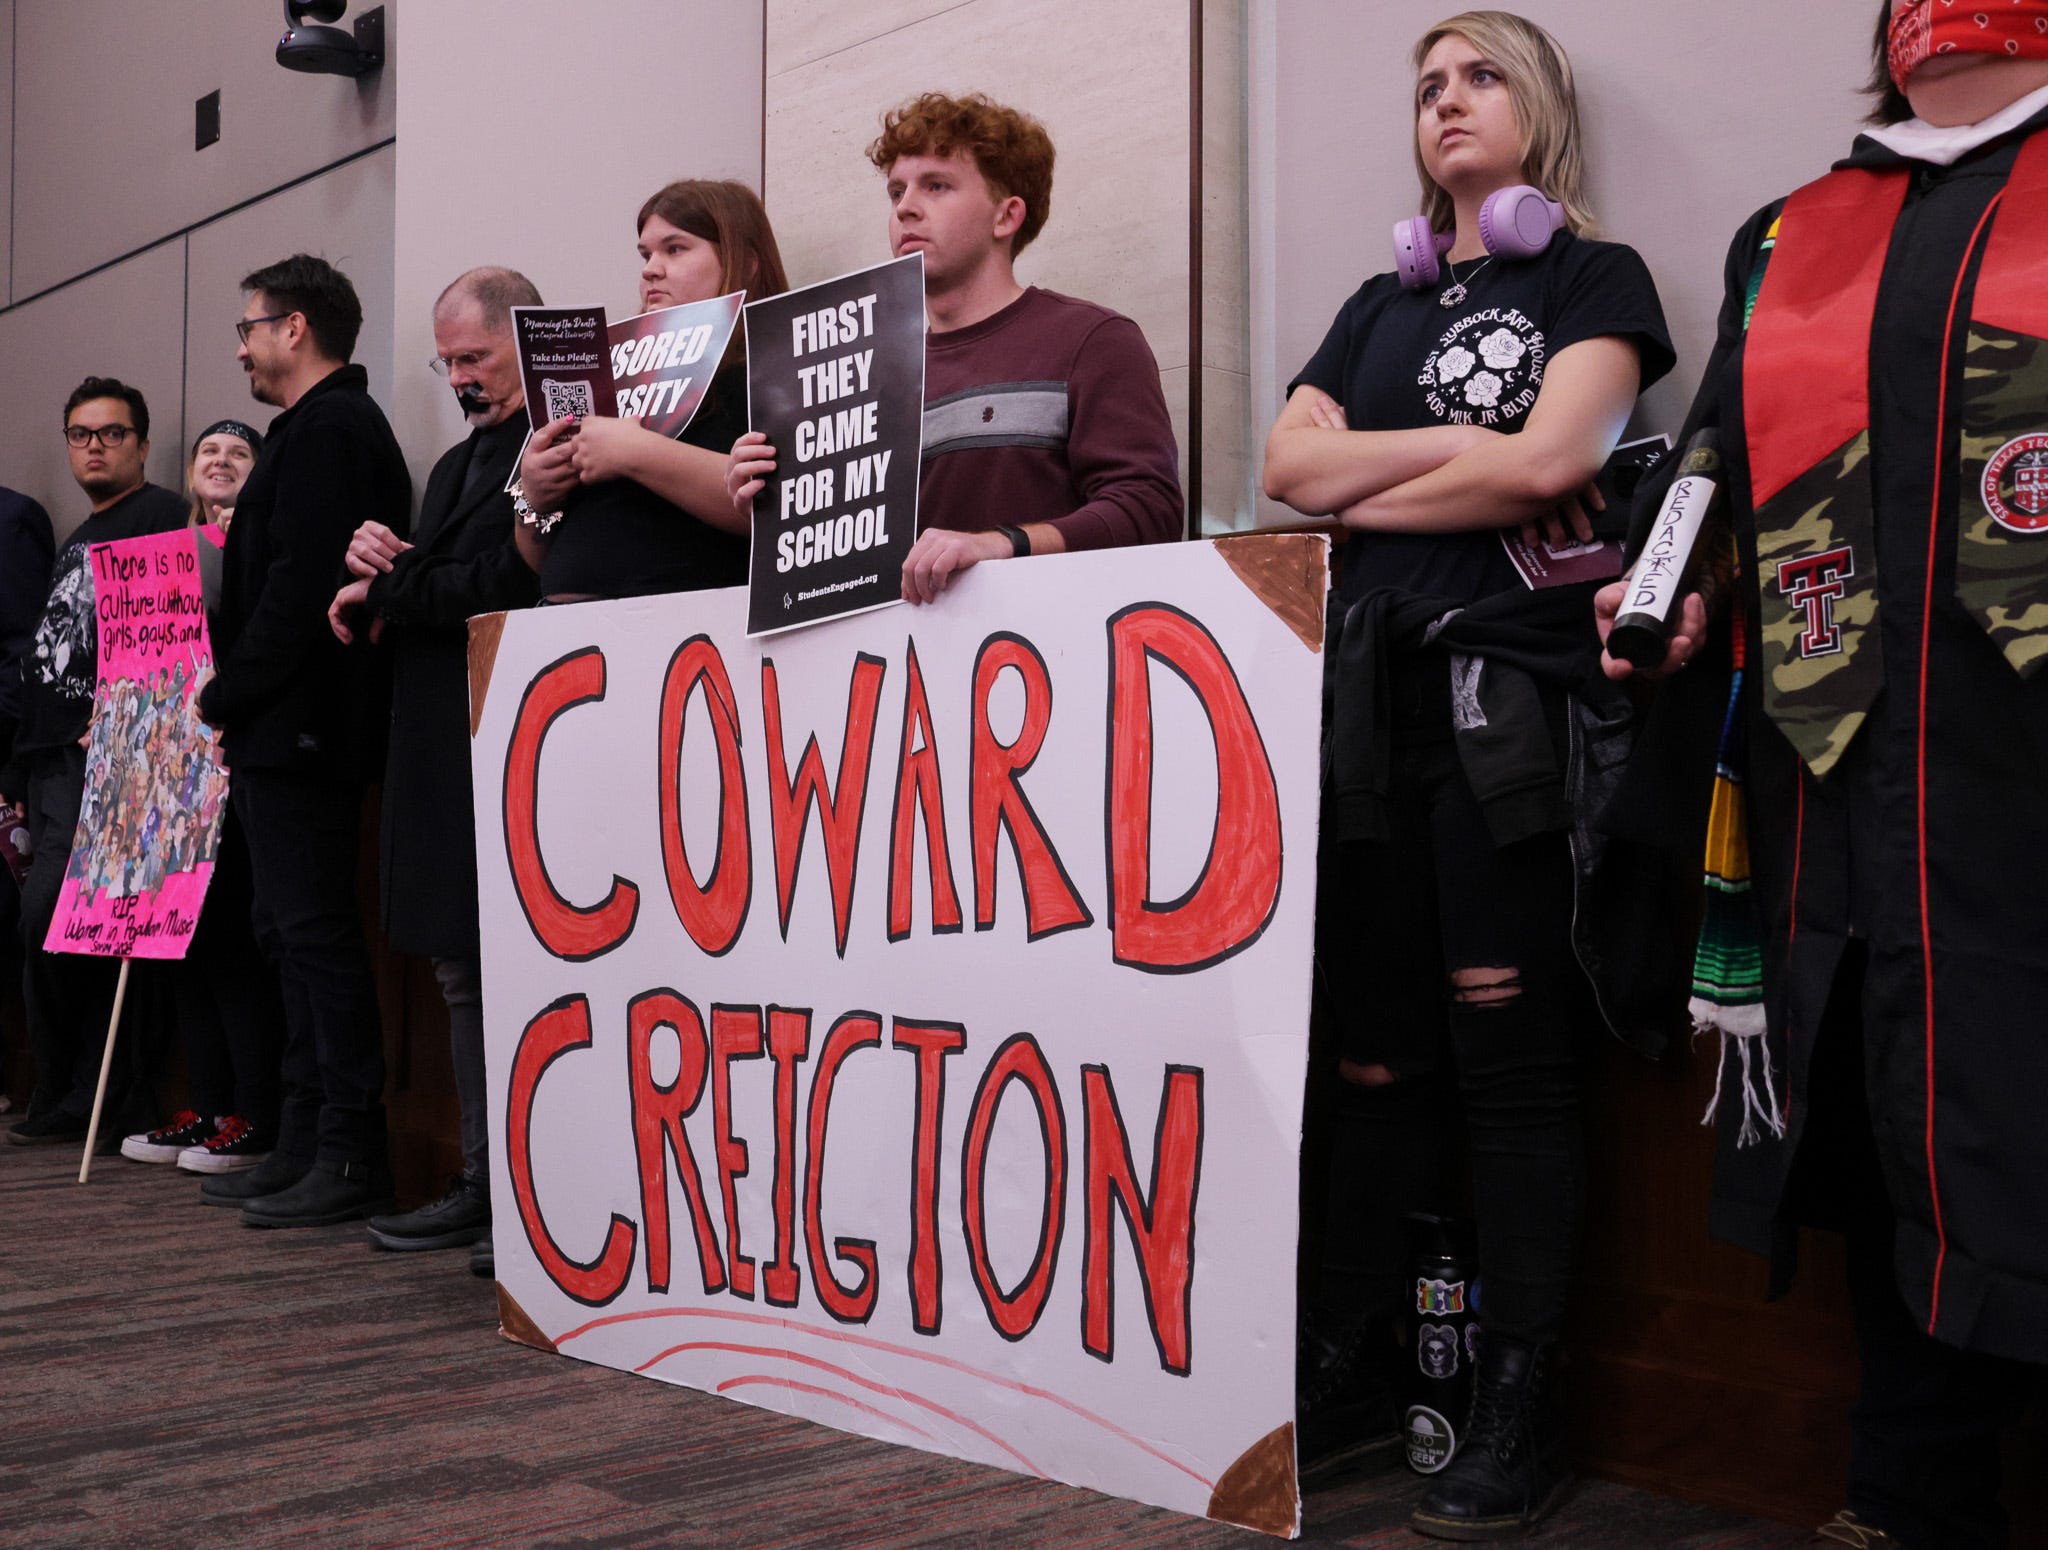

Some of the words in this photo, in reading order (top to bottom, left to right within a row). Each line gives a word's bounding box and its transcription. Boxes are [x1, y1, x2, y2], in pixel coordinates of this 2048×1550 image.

[523, 317, 562, 331] Mourning
[573, 316, 598, 328] Death
[791, 293, 878, 358] FIRST
[1502, 308, 1534, 332] ART
[531, 353, 551, 362] Take
[552, 353, 566, 362] the
[567, 352, 598, 363] Pledge:
[798, 348, 874, 408] THEY
[1425, 391, 1446, 417] 405
[1479, 409, 1499, 424] JR
[1501, 388, 1535, 419] BLVD
[795, 401, 878, 463] CAME
[1989, 442, 2024, 474] TEXAS
[780, 468, 833, 521] FOR
[844, 449, 892, 502] MY
[1986, 476, 1996, 491] OF
[1988, 493, 2009, 520] SEAL
[776, 504, 889, 574] SCHOOL
[92, 544, 147, 582] There
[155, 551, 168, 575] is
[176, 551, 194, 575] no
[100, 584, 155, 621] culture
[797, 573, 878, 602] StudentsEngaged.org
[104, 621, 136, 662] girls,
[139, 621, 177, 657] gays,
[180, 616, 203, 643] and
[502, 600, 1283, 975] COWARD
[64, 917, 103, 942] Women
[106, 922, 118, 940] in
[160, 908, 194, 936] Music
[111, 895, 139, 919] RIP
[505, 987, 1204, 1377] CREIGTON
[1411, 1451, 1436, 1465] GEEK
